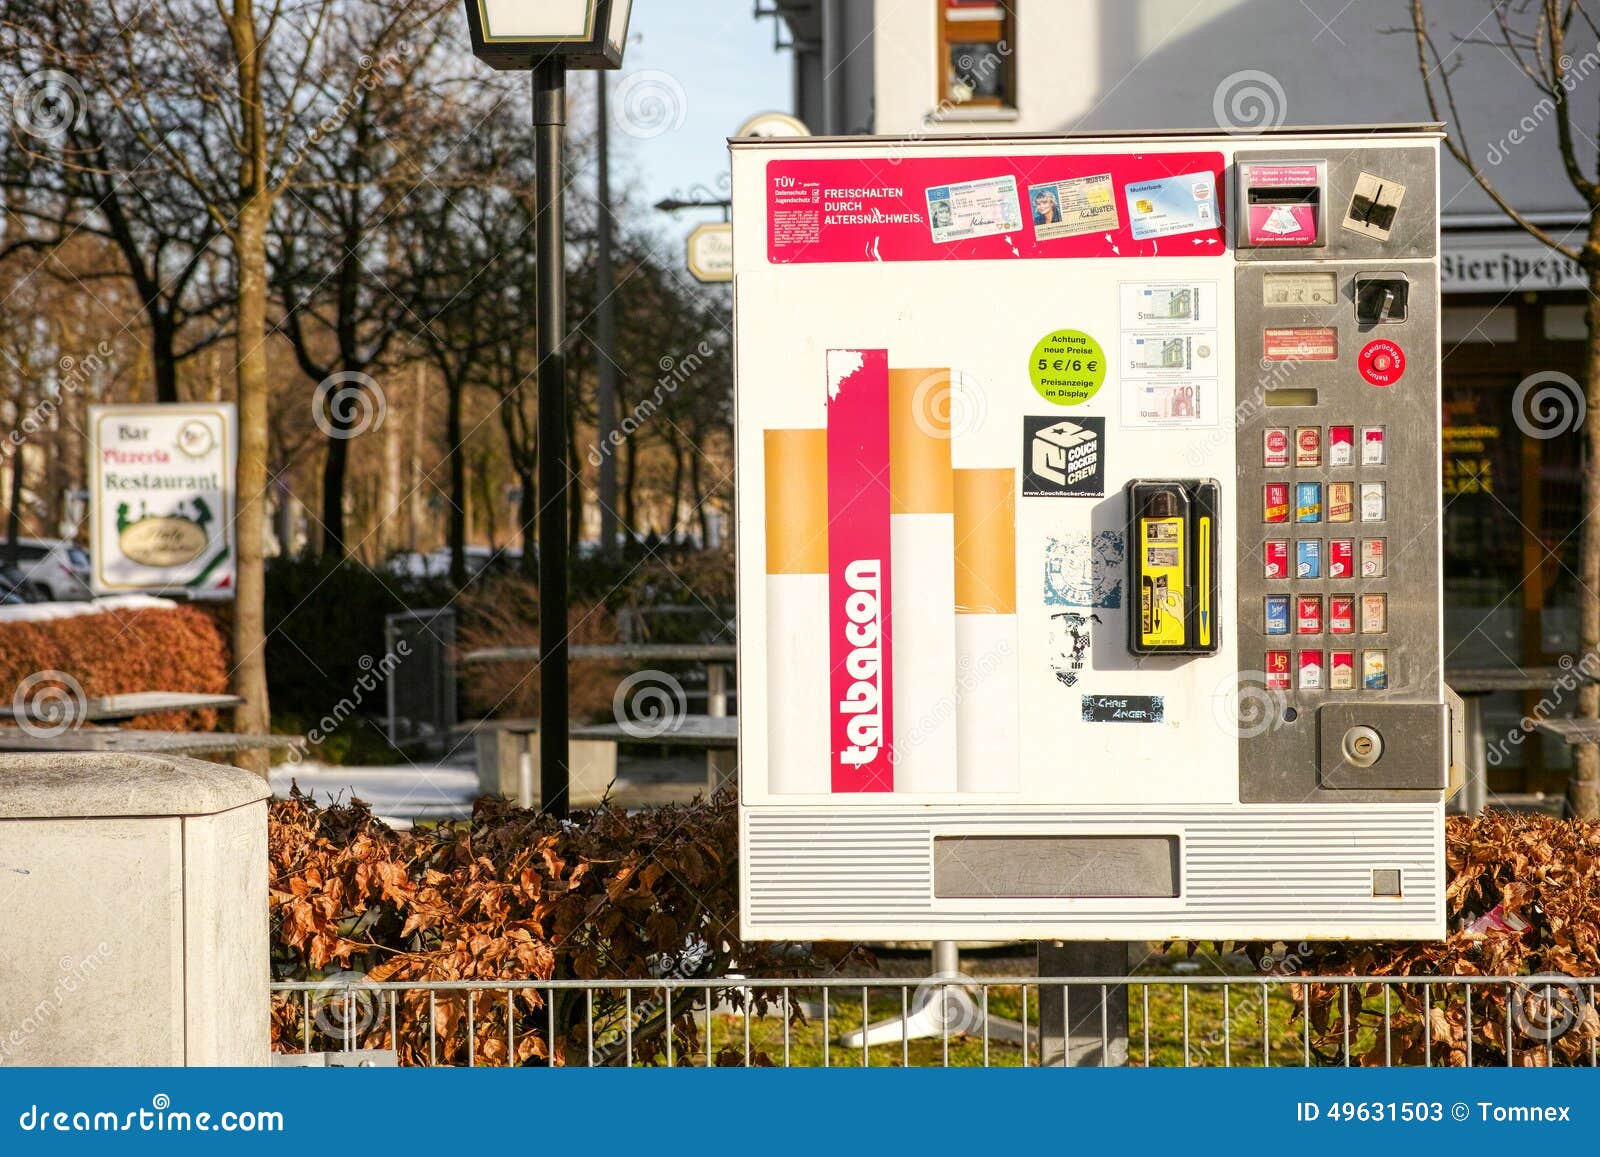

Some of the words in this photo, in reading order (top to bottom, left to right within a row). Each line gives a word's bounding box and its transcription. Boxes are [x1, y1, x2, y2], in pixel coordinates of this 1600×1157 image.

[774, 176, 795, 187] TÜV
[824, 188, 903, 198] FREISCHALTEN
[824, 202, 862, 212] DURCH
[824, 213, 924, 225] ALTERSNACHWEIS:
[1051, 336, 1086, 344] Achtung
[1038, 359, 1047, 370] 5
[1041, 379, 1094, 388] Preisanzeige
[1058, 389, 1089, 398] Display
[119, 424, 150, 441] Bar
[103, 448, 170, 464] Pizzeria
[1068, 440, 1097, 461] COUCH
[1068, 453, 1097, 473] ROCKER
[1067, 463, 1097, 484] CREW
[105, 473, 218, 490] Restaurant
[839, 559, 883, 766] tabacon
